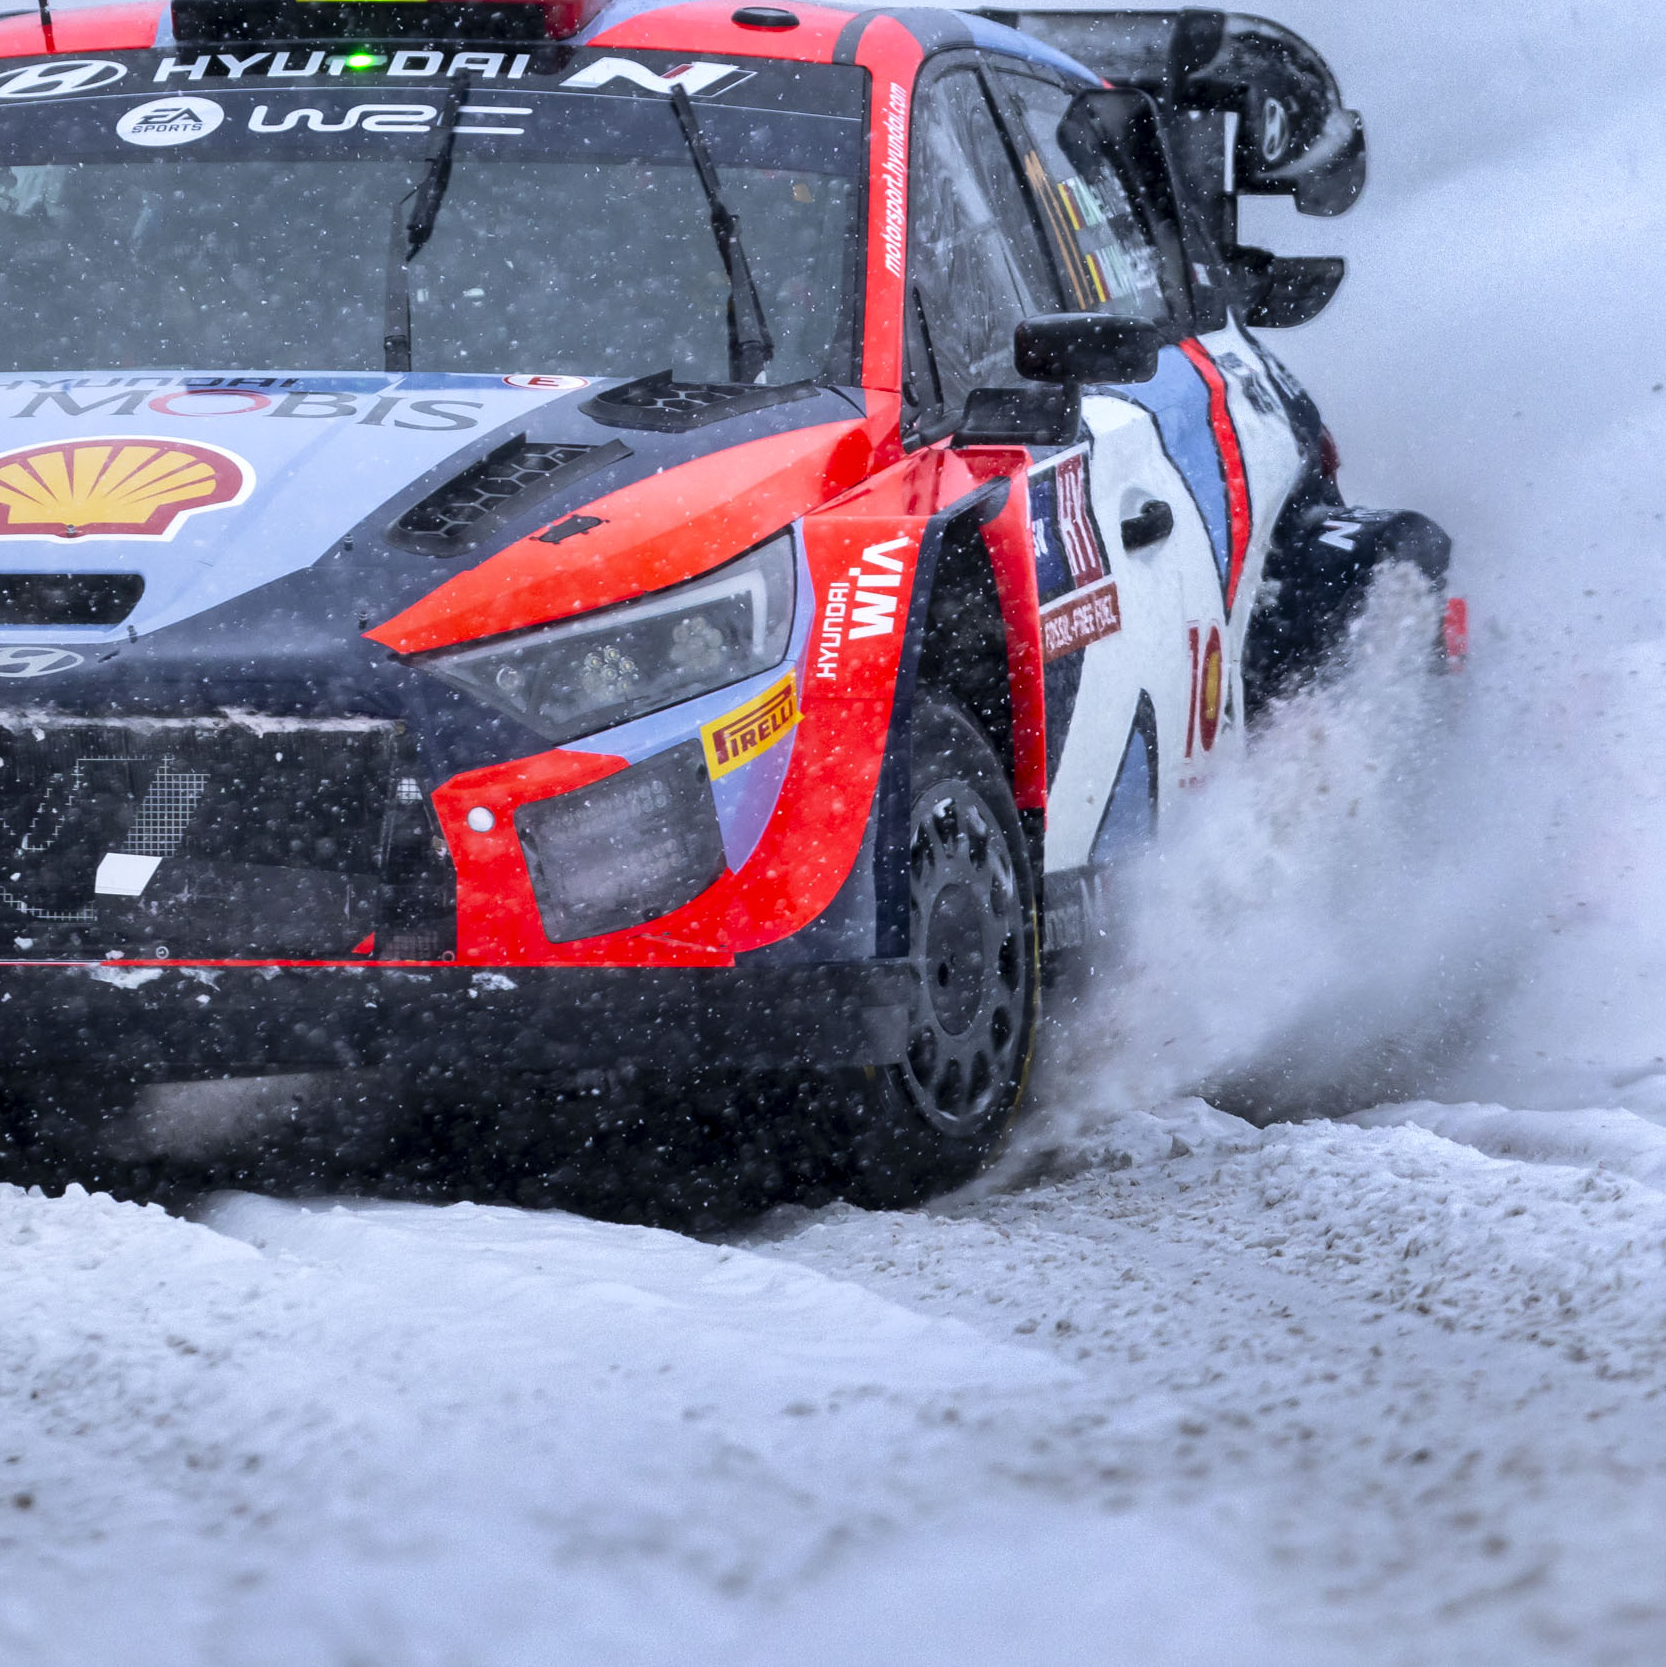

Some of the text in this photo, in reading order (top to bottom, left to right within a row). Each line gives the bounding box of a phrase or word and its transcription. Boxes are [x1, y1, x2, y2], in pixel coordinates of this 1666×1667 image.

[131, 123, 203, 134] SPORTS
[136, 107, 203, 124] EA
[247, 104, 533, 135] WRC
[880, 82, 907, 277] motorsport.hyundai.com
[527, 376, 563, 387] E
[9, 389, 484, 431] MOBIS
[816, 582, 850, 679] HYUNDAI
[712, 683, 793, 765] PIRELLI
